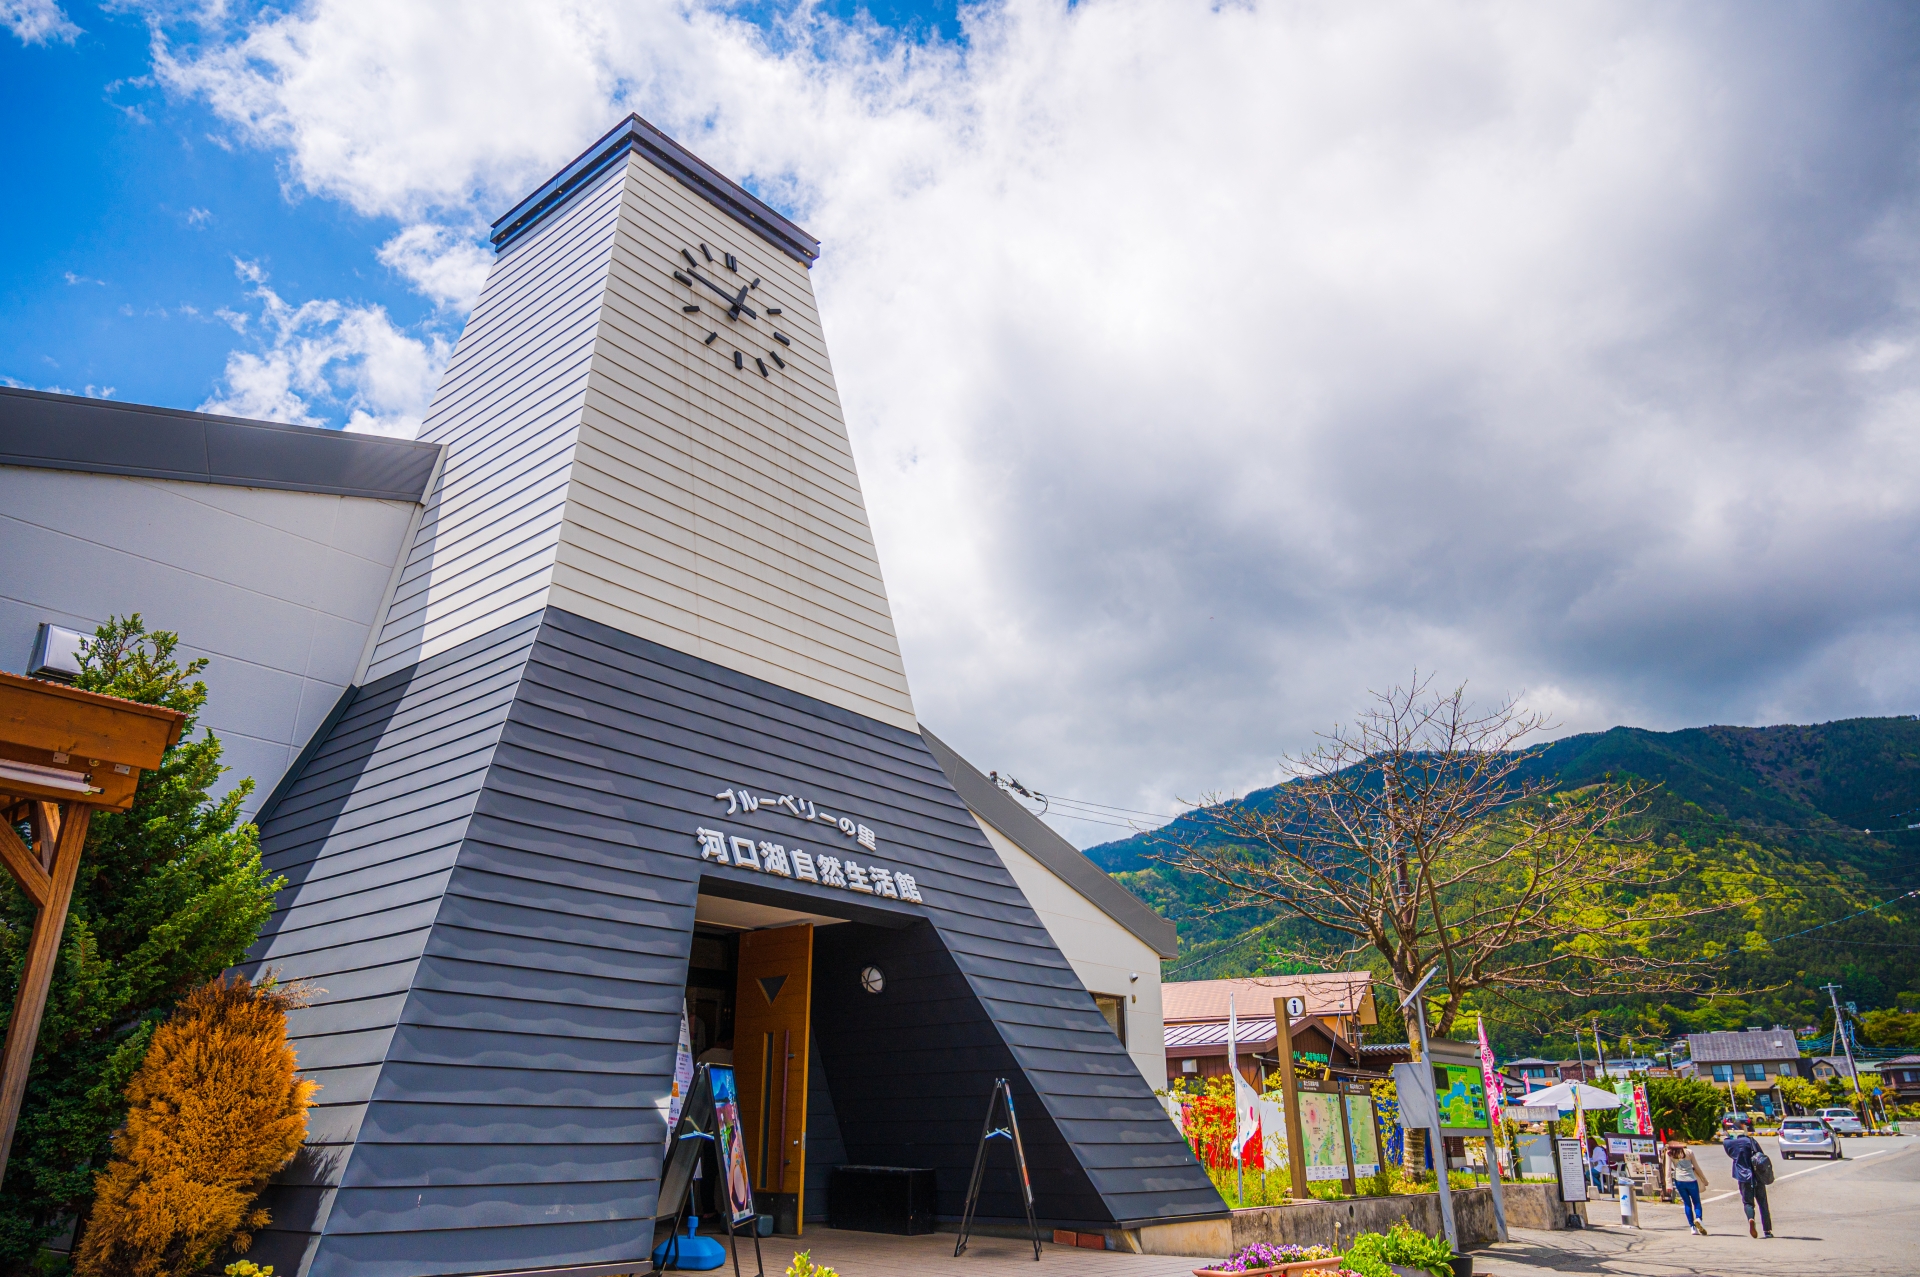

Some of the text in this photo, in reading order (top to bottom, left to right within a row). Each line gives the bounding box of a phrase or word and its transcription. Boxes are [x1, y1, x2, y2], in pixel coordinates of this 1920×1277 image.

[715, 787, 877, 852] ブルーベリーの里
[695, 826, 924, 904] 河口湖自然生活館
